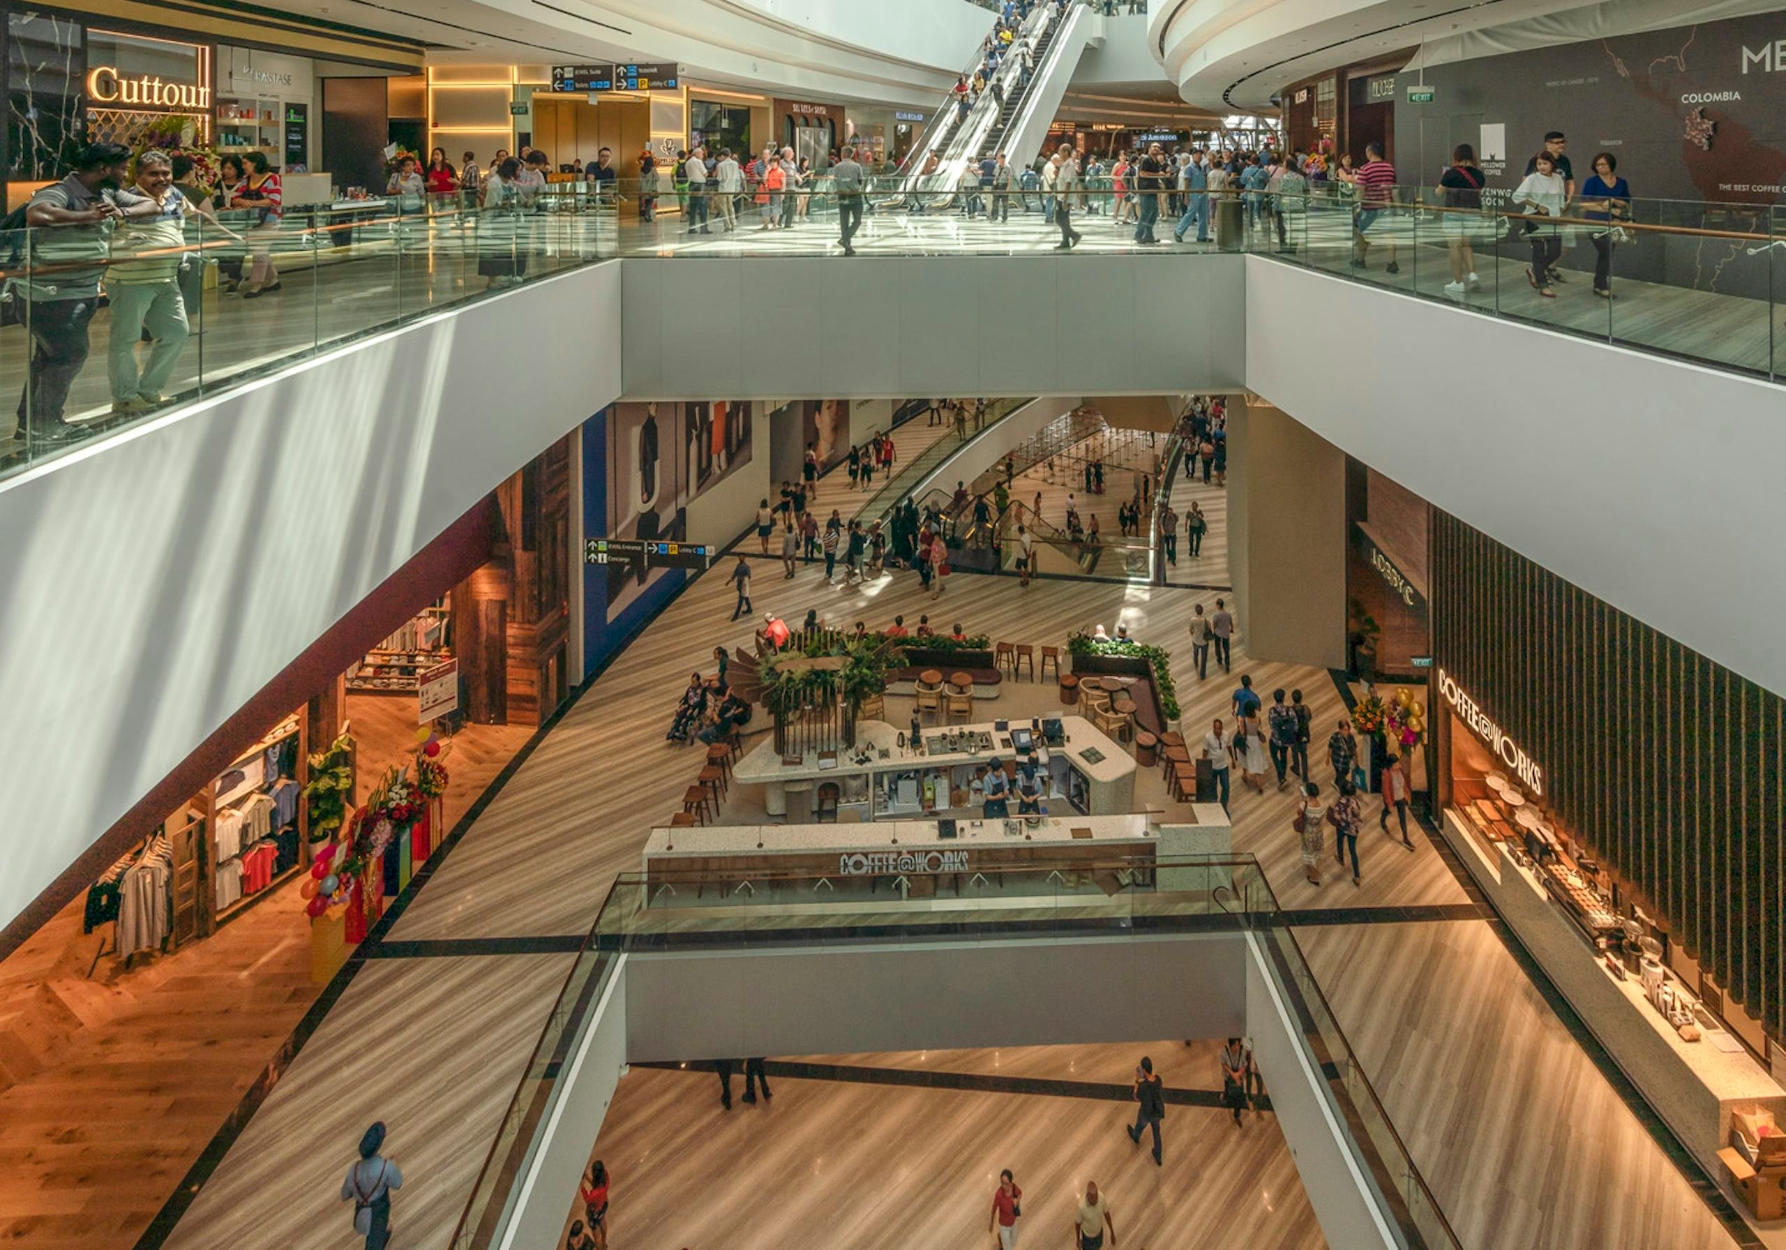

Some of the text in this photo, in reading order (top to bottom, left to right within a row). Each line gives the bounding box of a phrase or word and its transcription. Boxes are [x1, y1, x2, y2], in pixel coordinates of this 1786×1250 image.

[88, 66, 210, 108] Cuttour
[1681, 91, 1741, 104] COLOMBIA
[1148, 133, 1178, 141] Amazon
[1718, 183, 1732, 191] THE
[1733, 184, 1750, 192] BEST
[1751, 184, 1781, 193] COFFEE
[1371, 548, 1414, 605] LOBBY C
[1439, 668, 1541, 796] COFFEE@WORKS
[839, 850, 969, 875] COFFEE@WORKS
